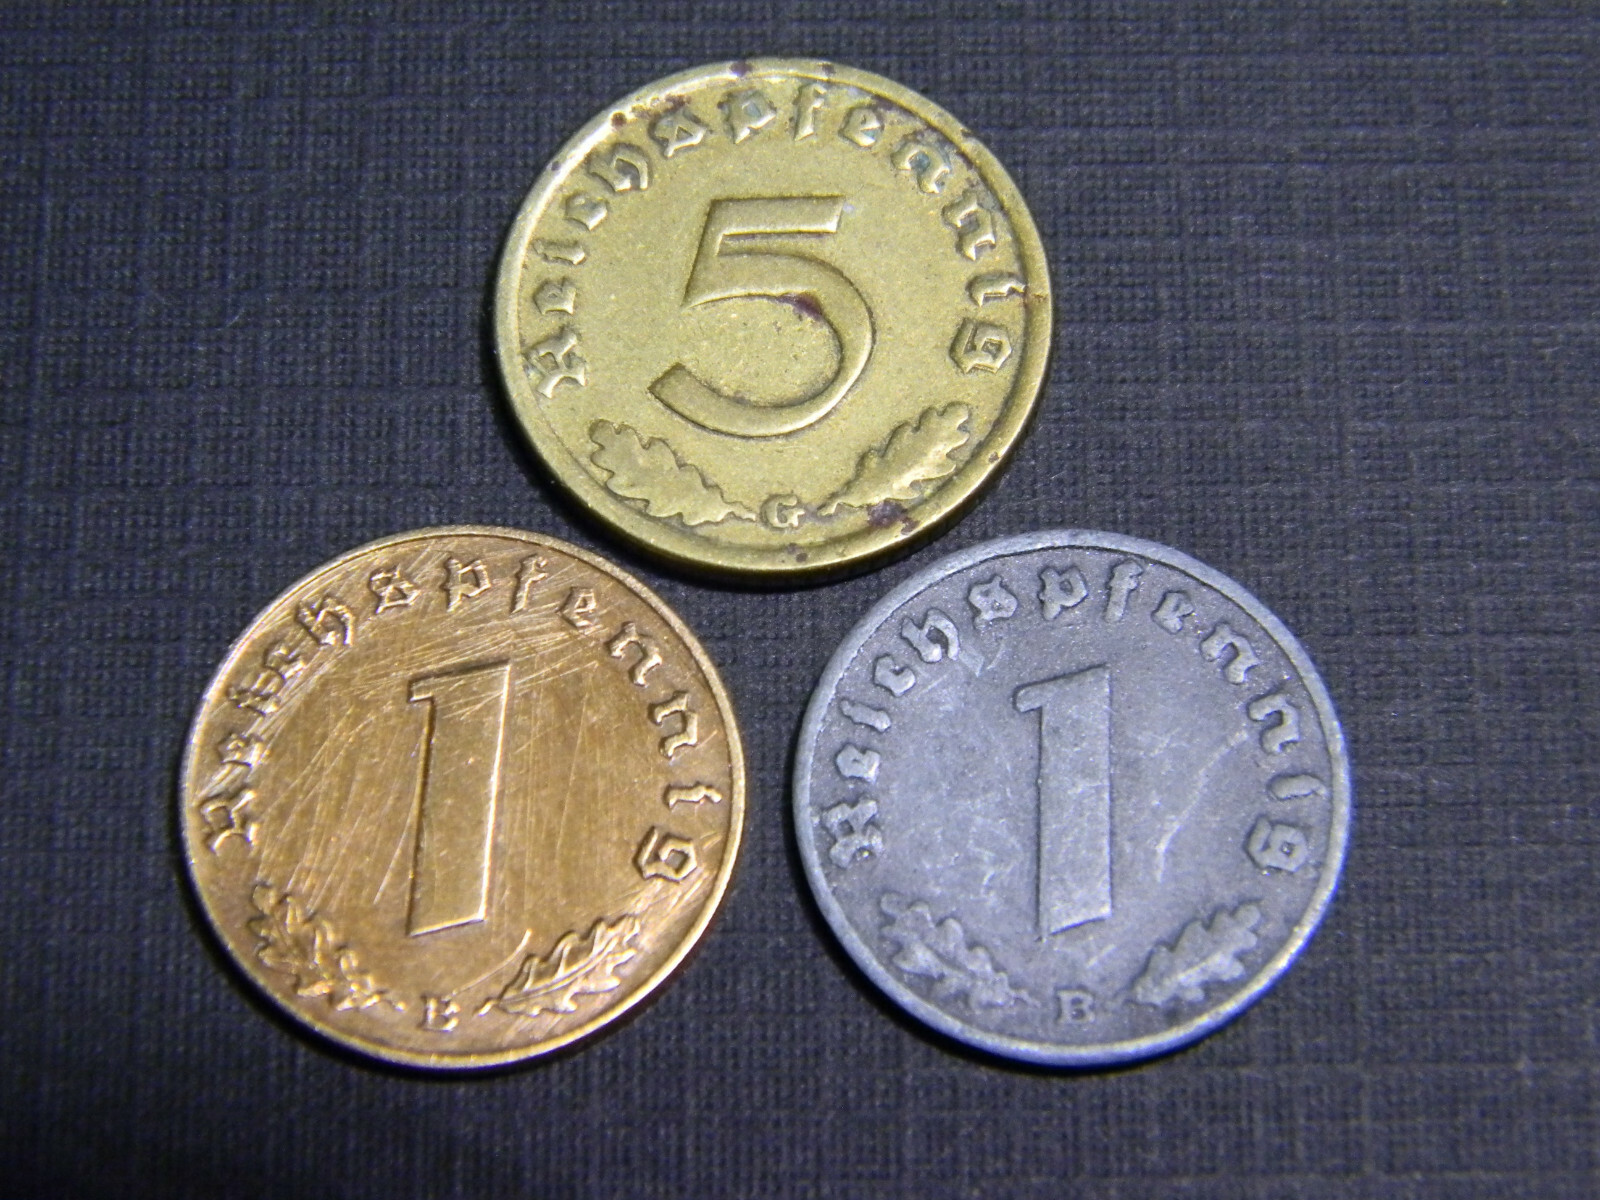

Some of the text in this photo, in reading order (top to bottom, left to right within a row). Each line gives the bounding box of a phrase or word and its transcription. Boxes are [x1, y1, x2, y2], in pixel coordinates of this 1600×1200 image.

[648, 194, 876, 438] 5
[759, 491, 805, 529] G
[408, 658, 513, 938] 1
[1012, 662, 1114, 942] 1
[1056, 988, 1097, 1035] B
